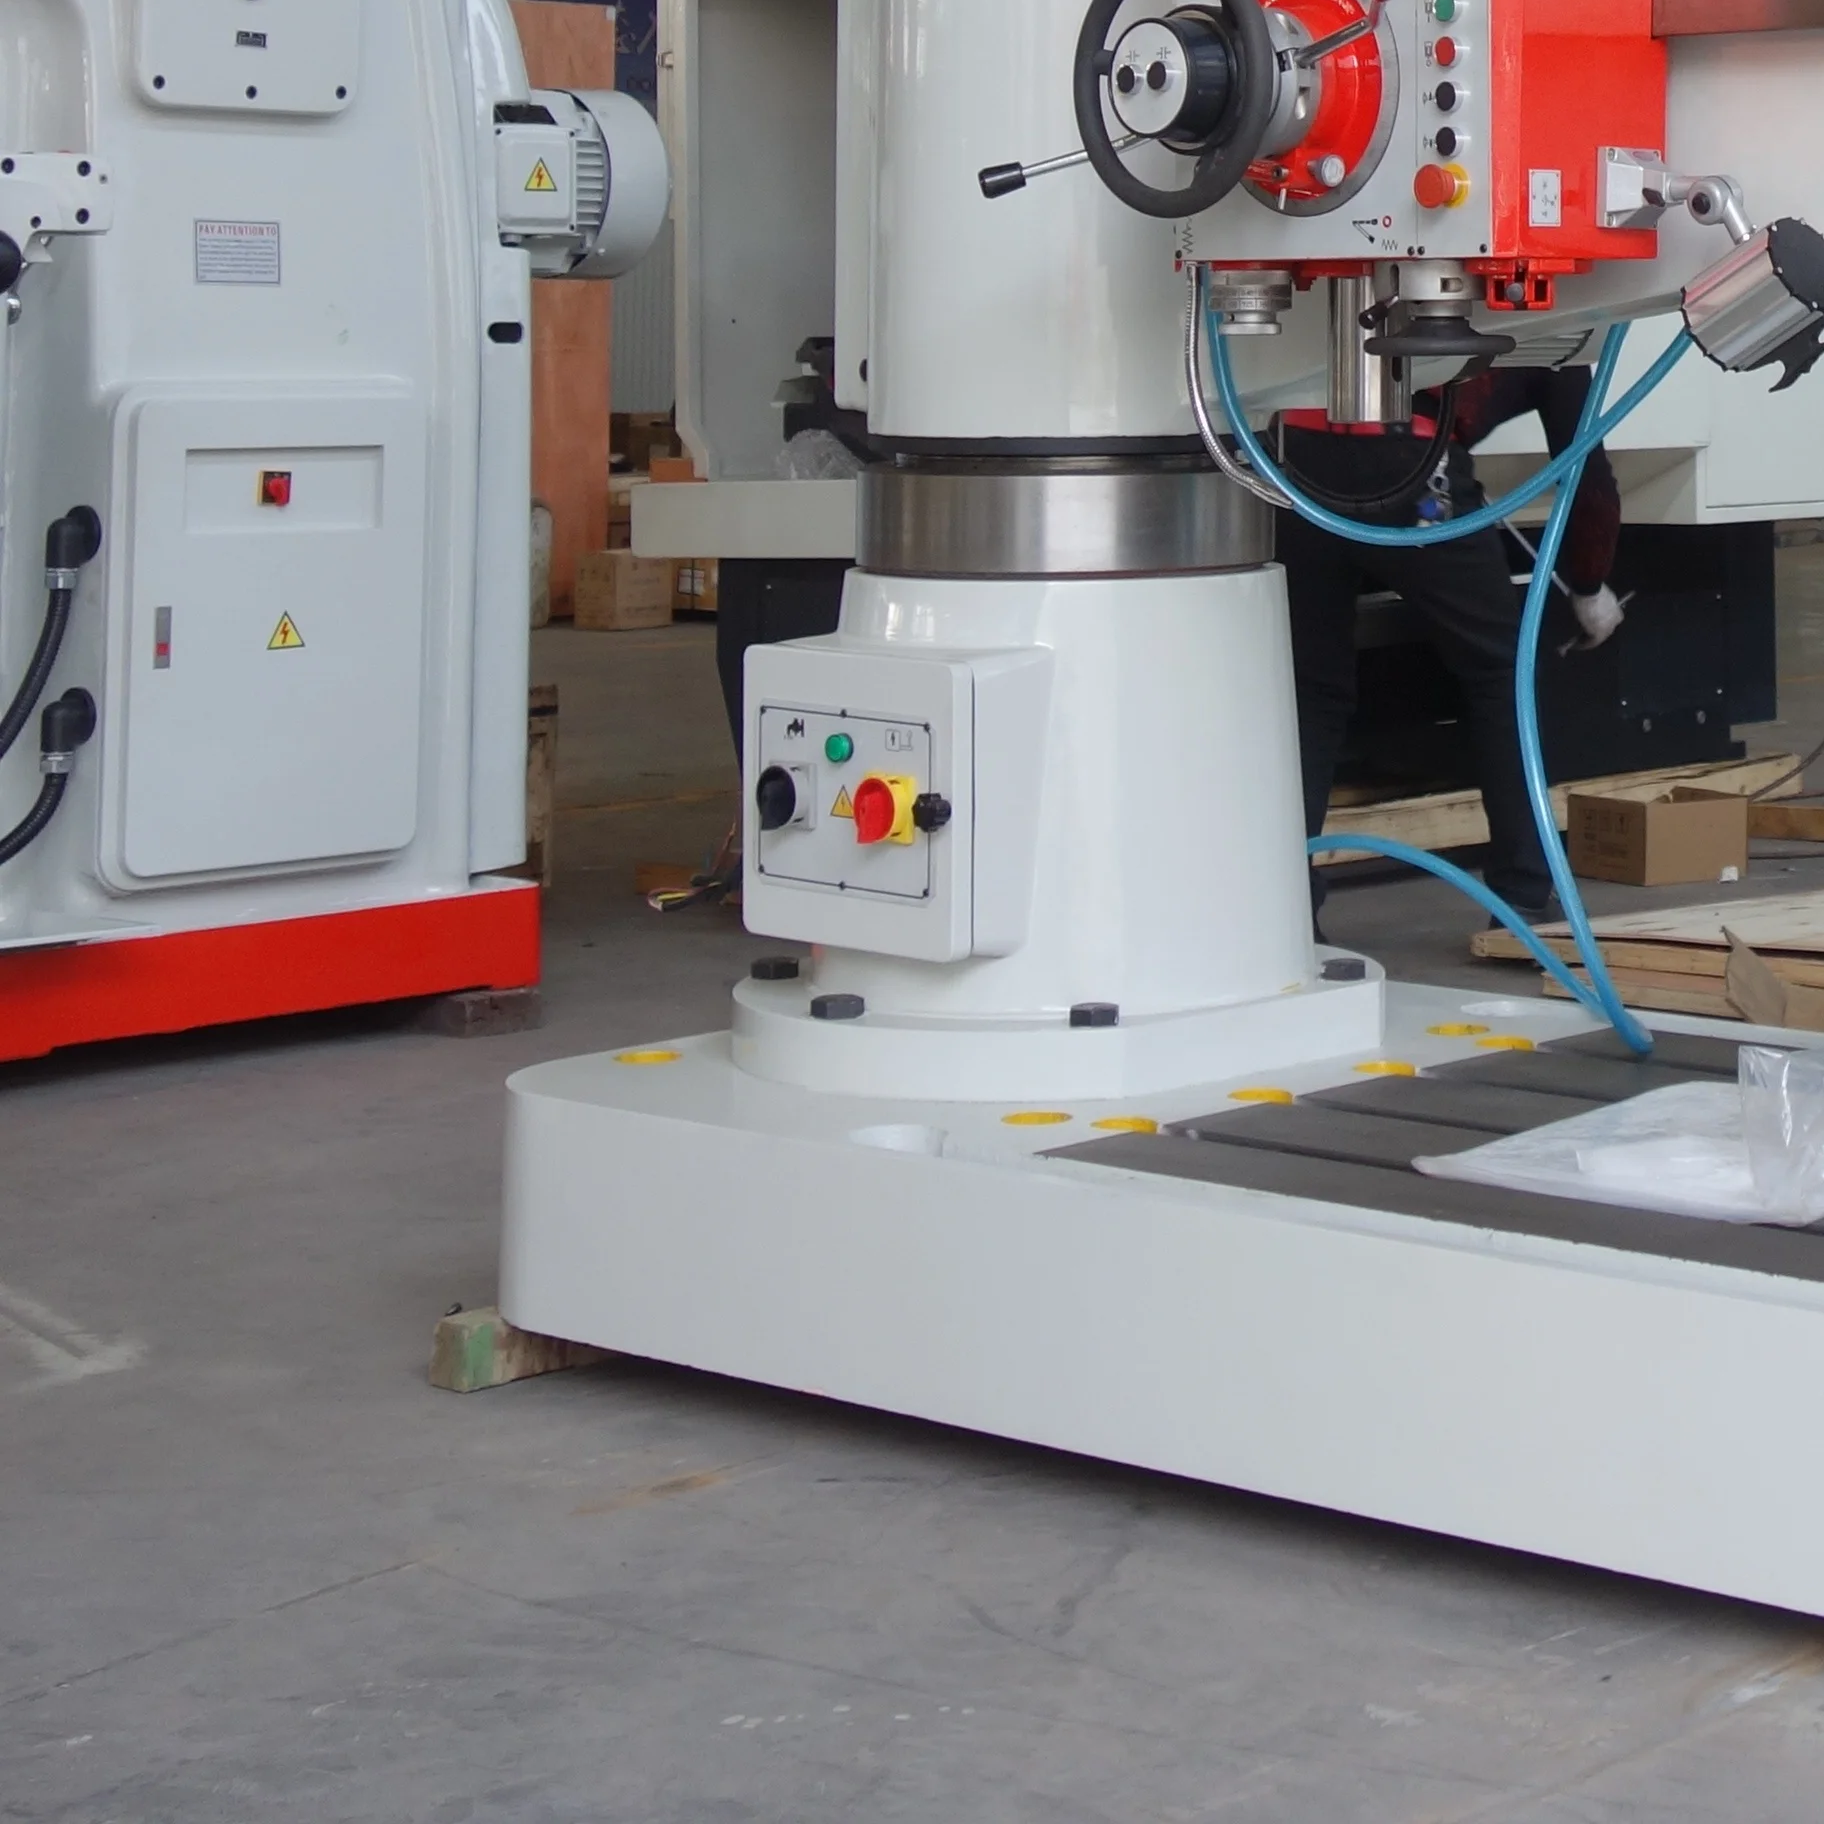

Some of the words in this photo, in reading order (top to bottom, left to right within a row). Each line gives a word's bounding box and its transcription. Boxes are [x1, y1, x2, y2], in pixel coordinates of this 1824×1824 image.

[199, 224, 215, 235] PAY
[217, 225, 264, 236] ATTENTION
[266, 226, 277, 236] TO
